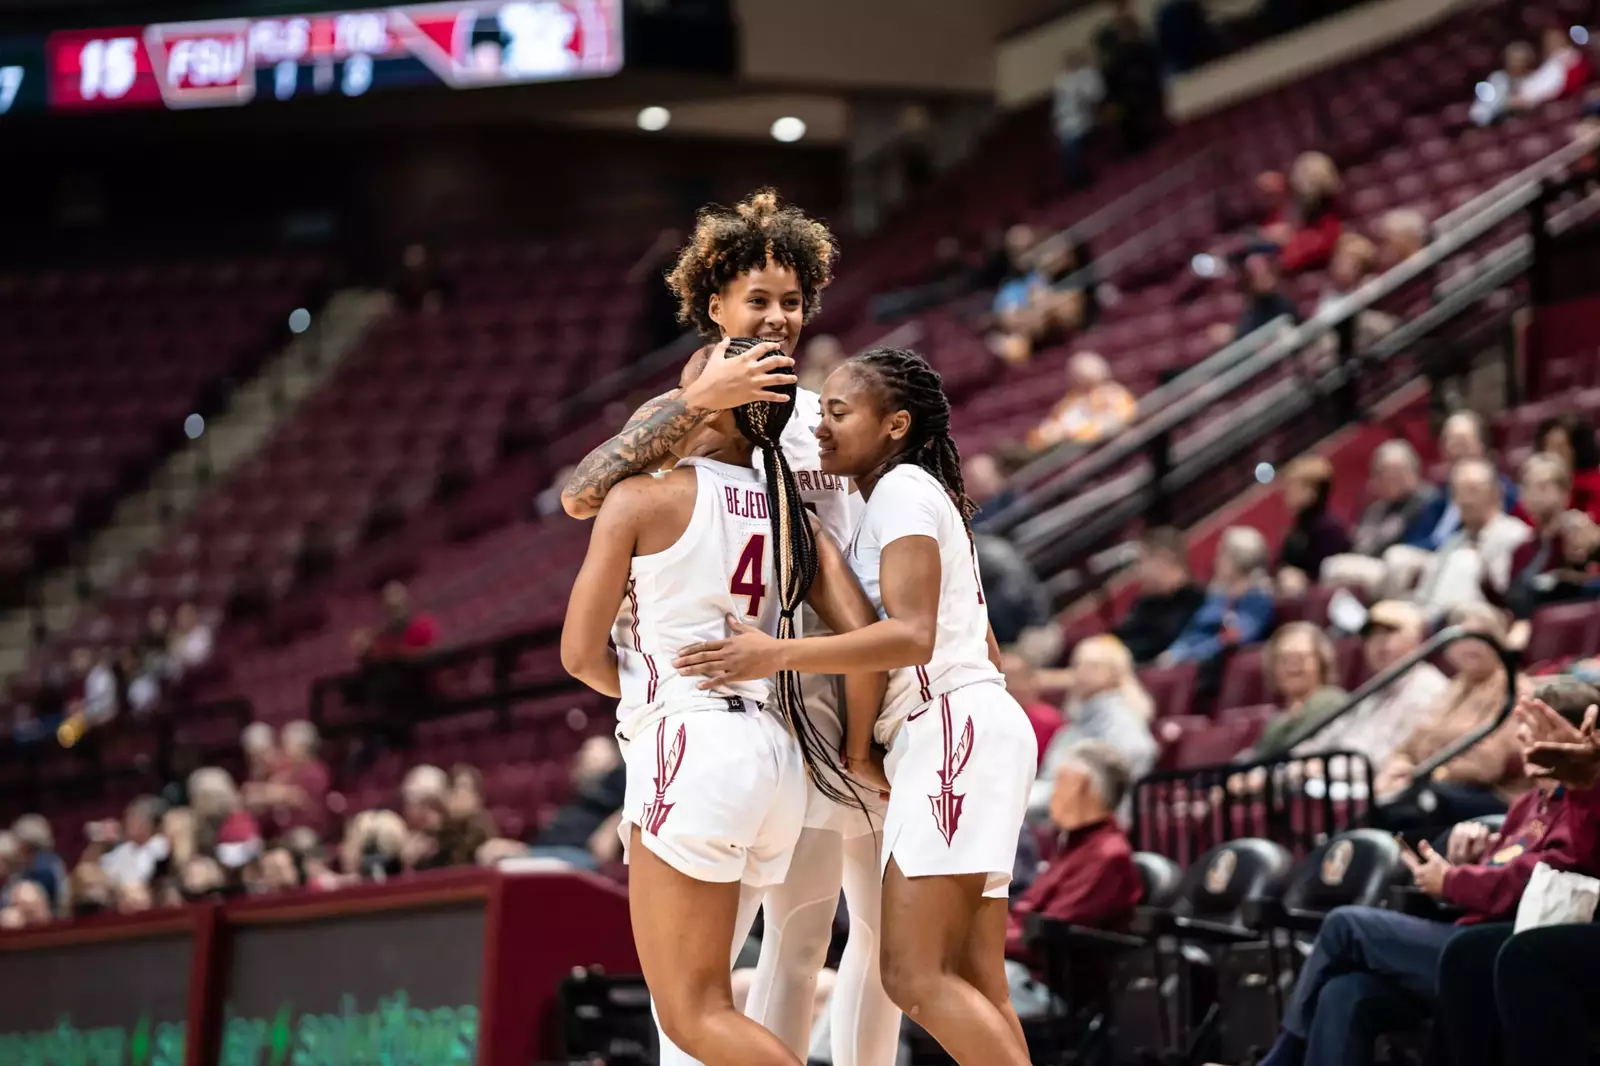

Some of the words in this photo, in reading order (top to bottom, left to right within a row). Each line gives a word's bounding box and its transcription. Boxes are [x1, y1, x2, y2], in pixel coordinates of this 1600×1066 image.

[167, 38, 246, 86] FSU
[792, 470, 844, 491] RIDA
[729, 533, 766, 618] 4
